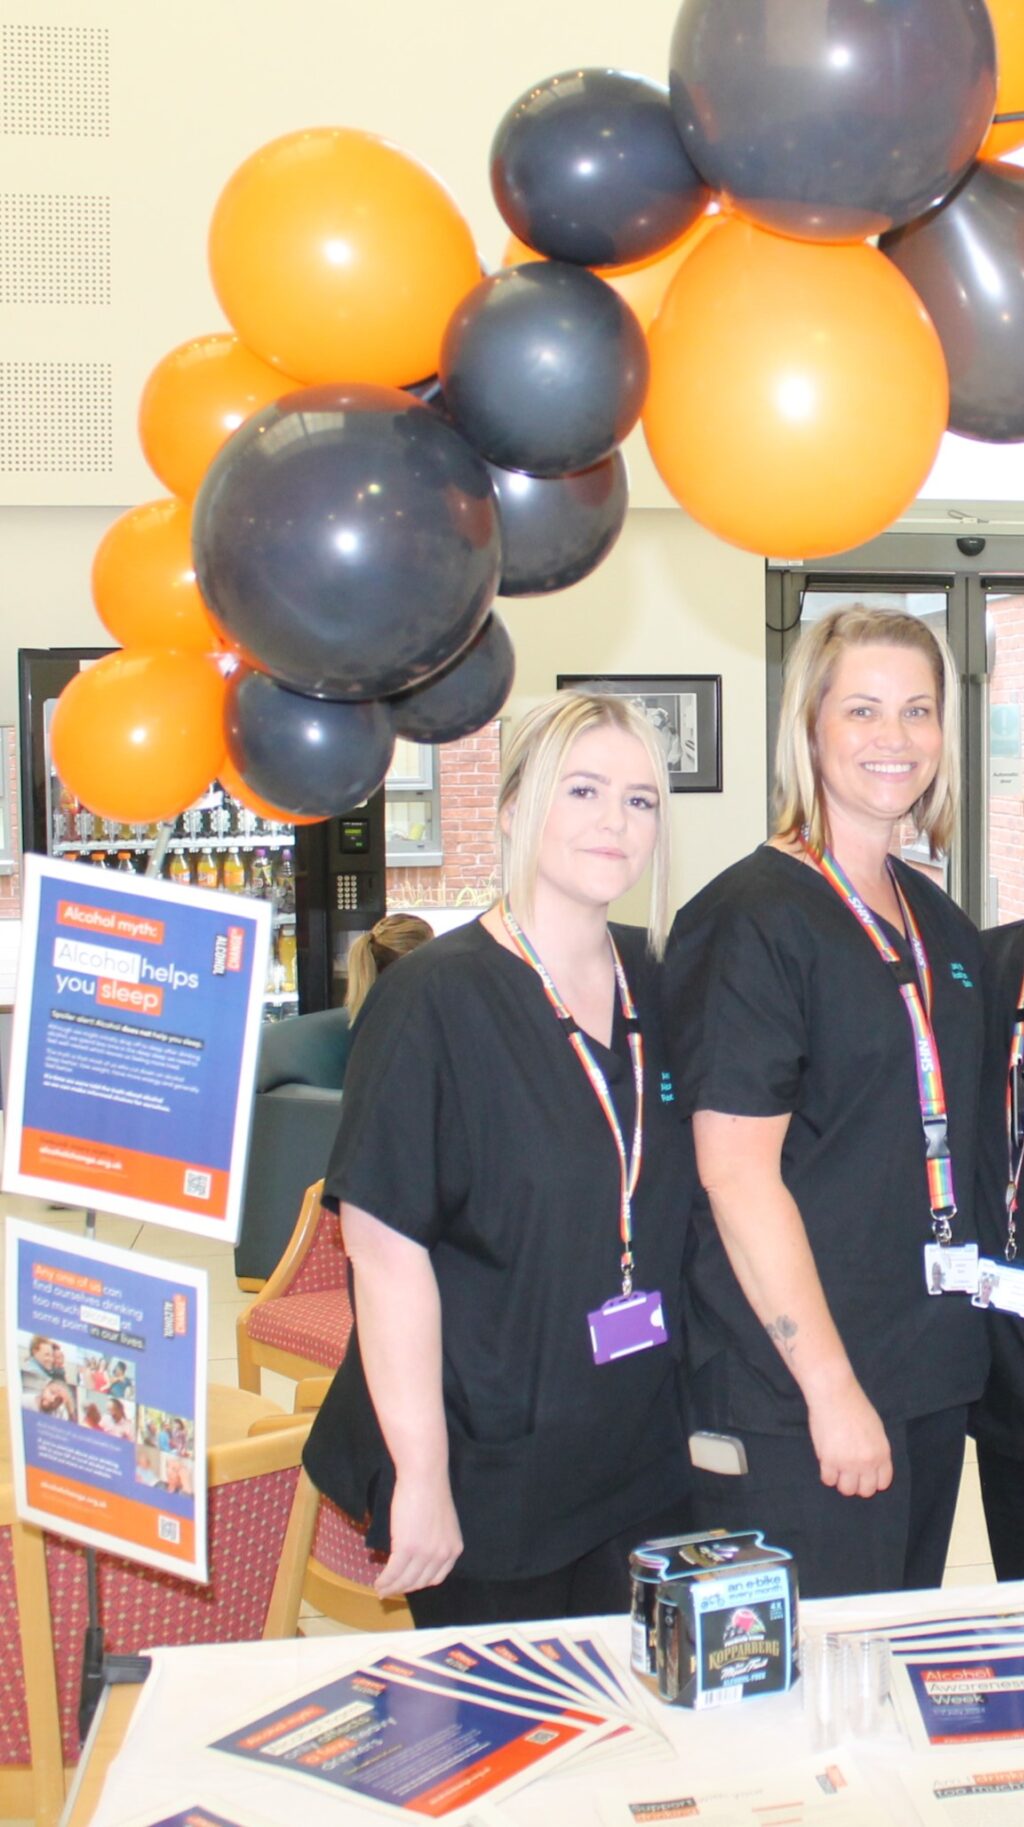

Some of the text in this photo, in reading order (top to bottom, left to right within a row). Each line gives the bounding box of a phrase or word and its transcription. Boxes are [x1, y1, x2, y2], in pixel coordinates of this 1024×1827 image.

[63, 905, 159, 938] Alcohol myth:
[57, 942, 200, 991] Alcohol helps
[55, 973, 160, 1011] you sleep
[918, 1039, 934, 1073] NHS
[32, 1294, 133, 1331] too much at
[32, 1310, 61, 1326] some
[61, 1317, 89, 1334] point
[101, 1299, 144, 1322] drinking
[727, 1582, 744, 1593] an
[708, 1640, 780, 1671] KOPPARBERG
[925, 1667, 991, 1682] Alcohol
[931, 1694, 985, 1705] Week
